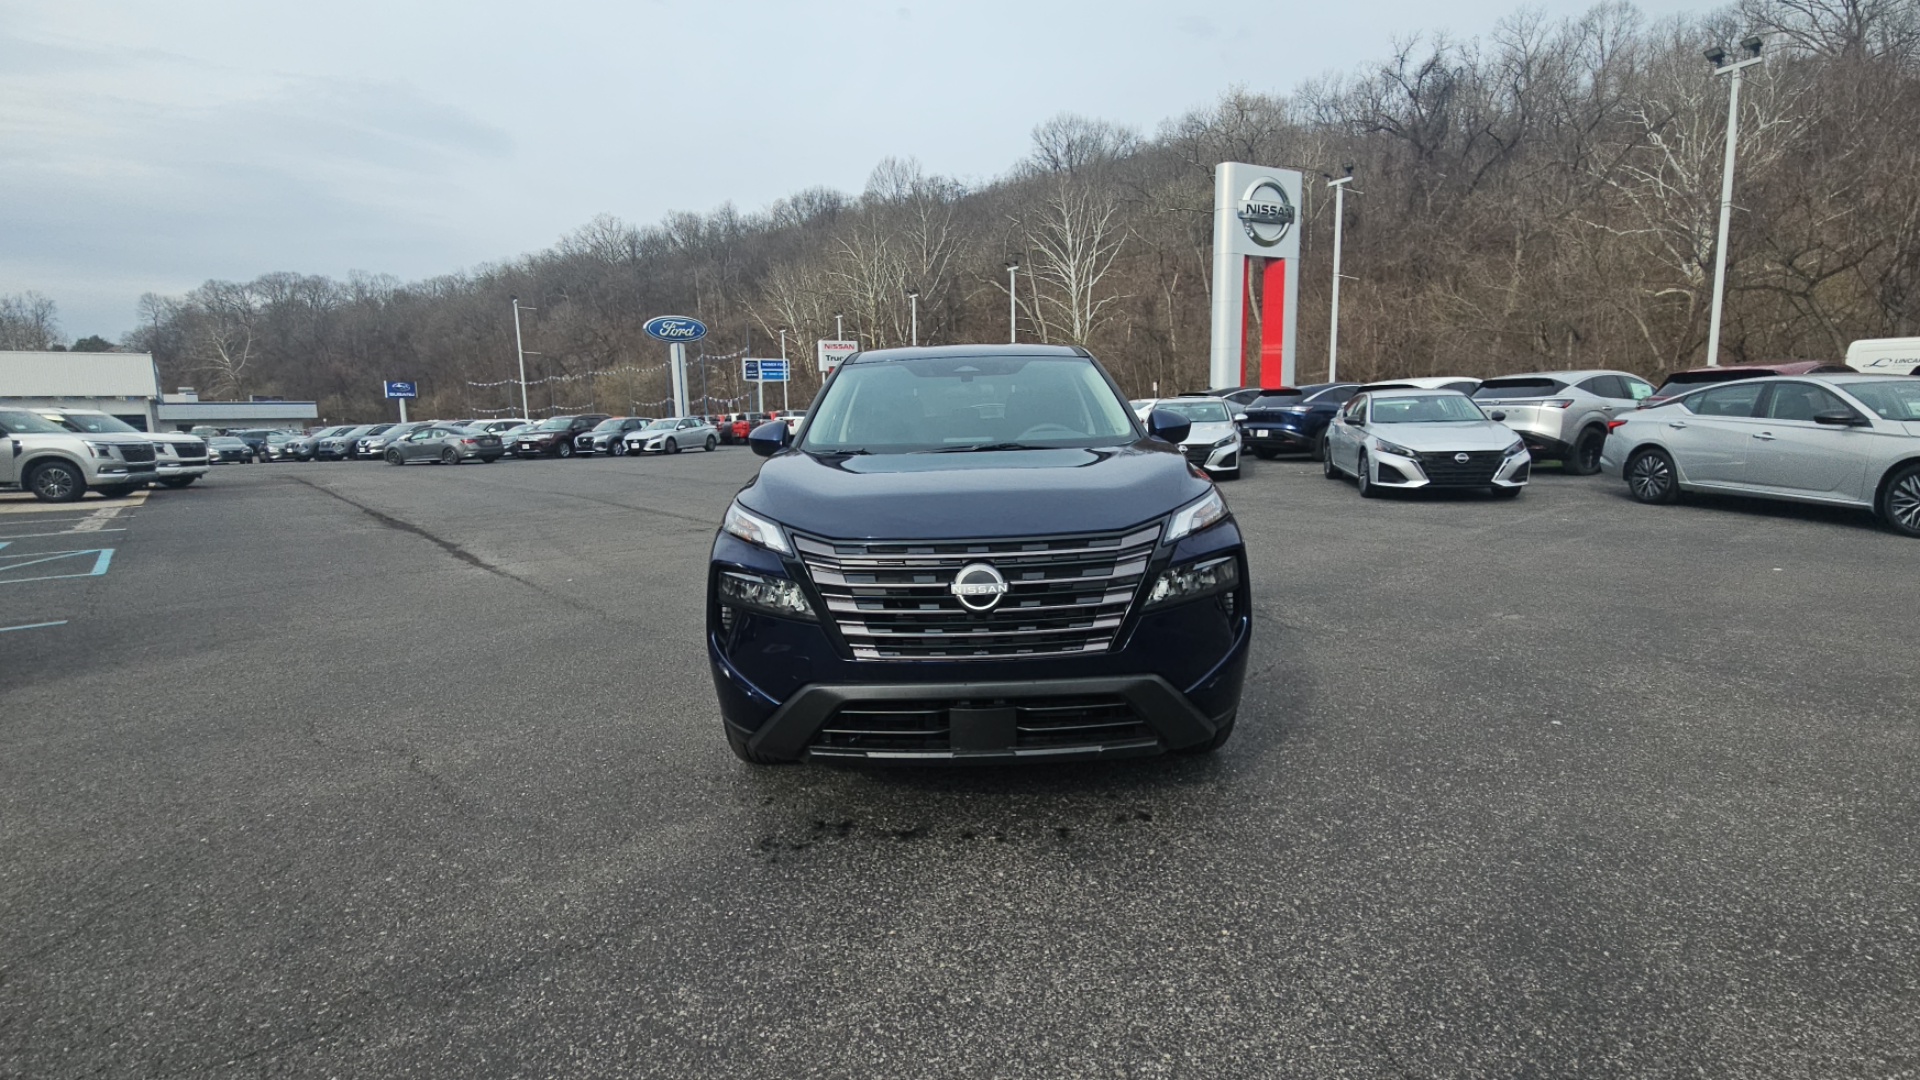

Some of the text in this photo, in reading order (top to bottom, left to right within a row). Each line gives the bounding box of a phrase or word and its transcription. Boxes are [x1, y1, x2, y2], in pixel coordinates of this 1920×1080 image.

[1246, 203, 1293, 218] NISSAN
[660, 320, 695, 336] Ford
[952, 584, 1008, 595] NISSAN
